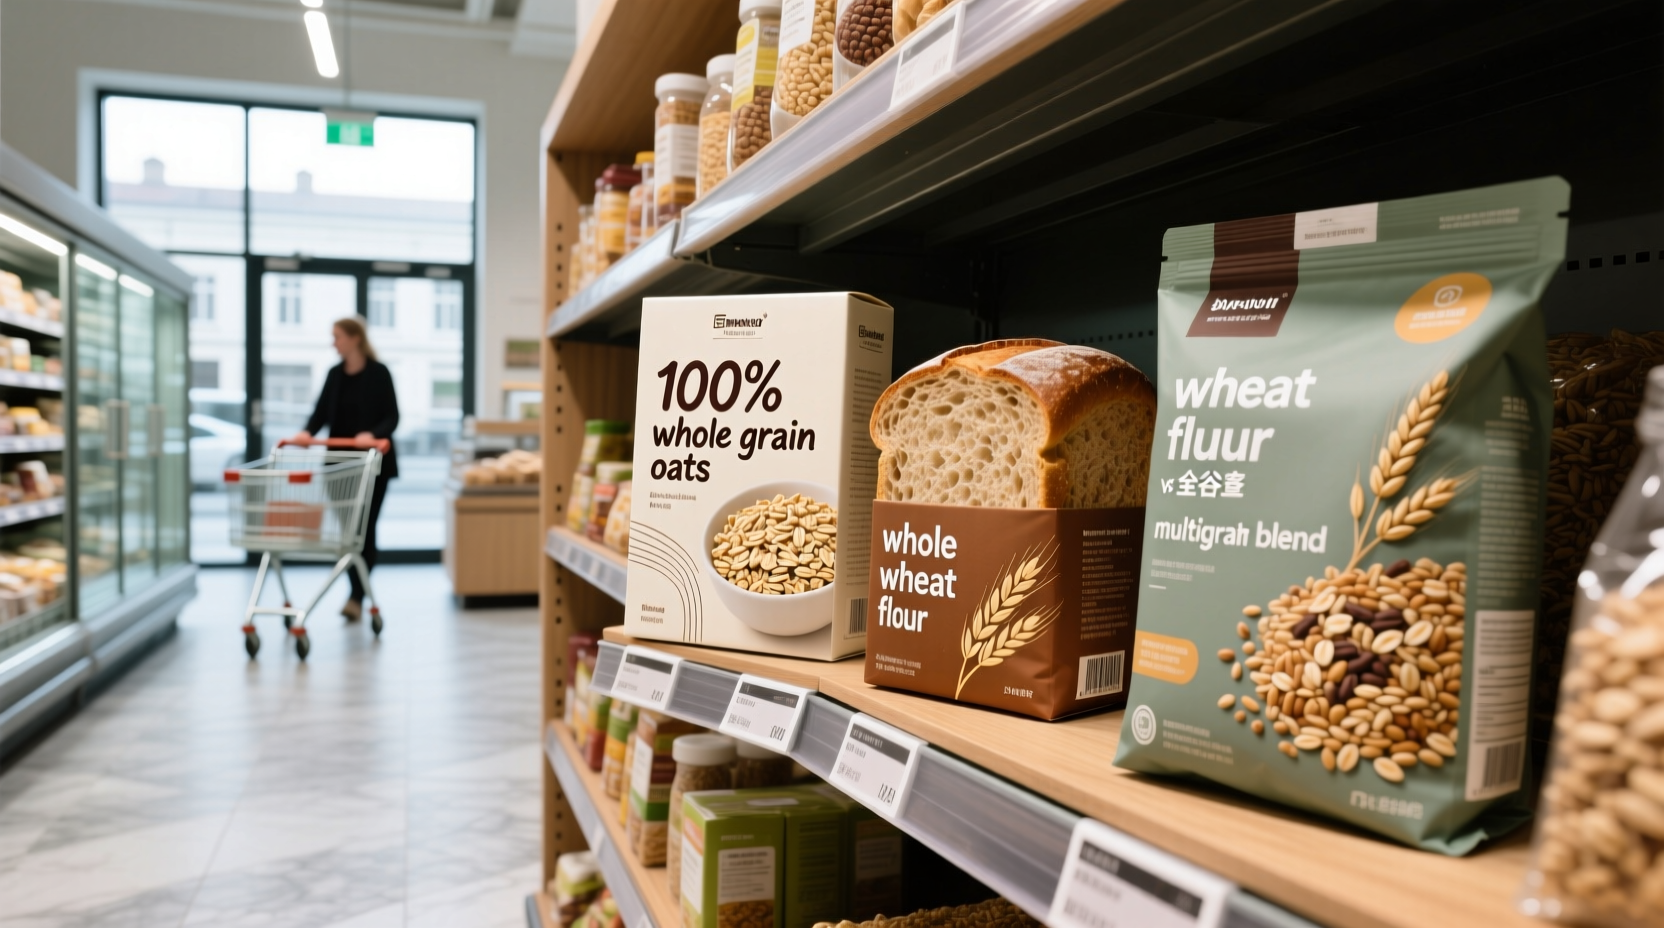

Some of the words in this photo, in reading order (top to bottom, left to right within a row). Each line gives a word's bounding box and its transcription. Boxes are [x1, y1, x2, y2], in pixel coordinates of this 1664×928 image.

[657, 359, 783, 413] 100%
[1175, 366, 1318, 409] wheat
[653, 415, 732, 449] whole
[737, 419, 816, 461] grain
[1167, 415, 1275, 462] fluur
[650, 452, 711, 482] oats
[882, 521, 958, 560] whole
[1255, 520, 1328, 553] blend
[879, 560, 957, 599] wheat
[877, 594, 929, 633] flour
